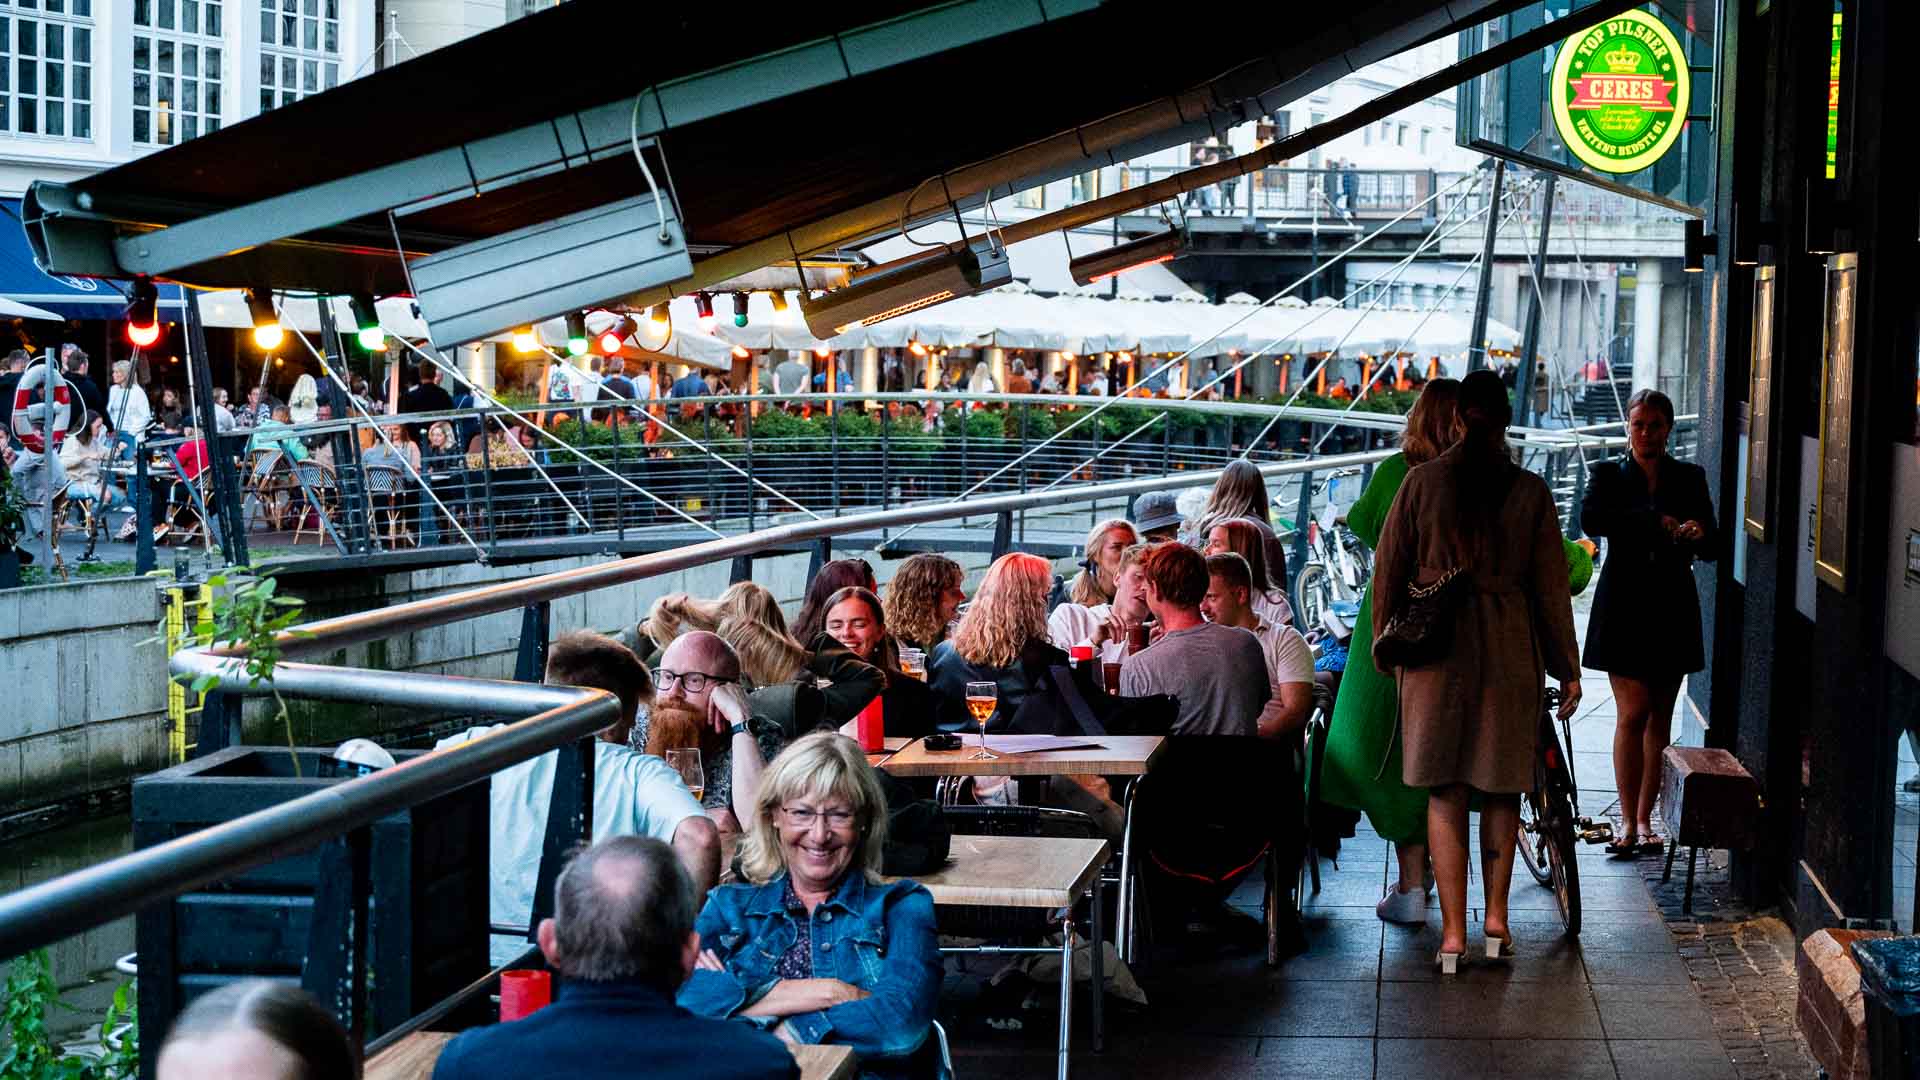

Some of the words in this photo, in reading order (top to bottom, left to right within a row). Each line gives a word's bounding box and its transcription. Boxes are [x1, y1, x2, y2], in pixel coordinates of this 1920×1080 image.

[1578, 29, 1605, 57] TOP
[1607, 21, 1669, 60] PILSNER
[1590, 79, 1654, 100] CERES
[1618, 132, 1656, 156] BEDSTE
